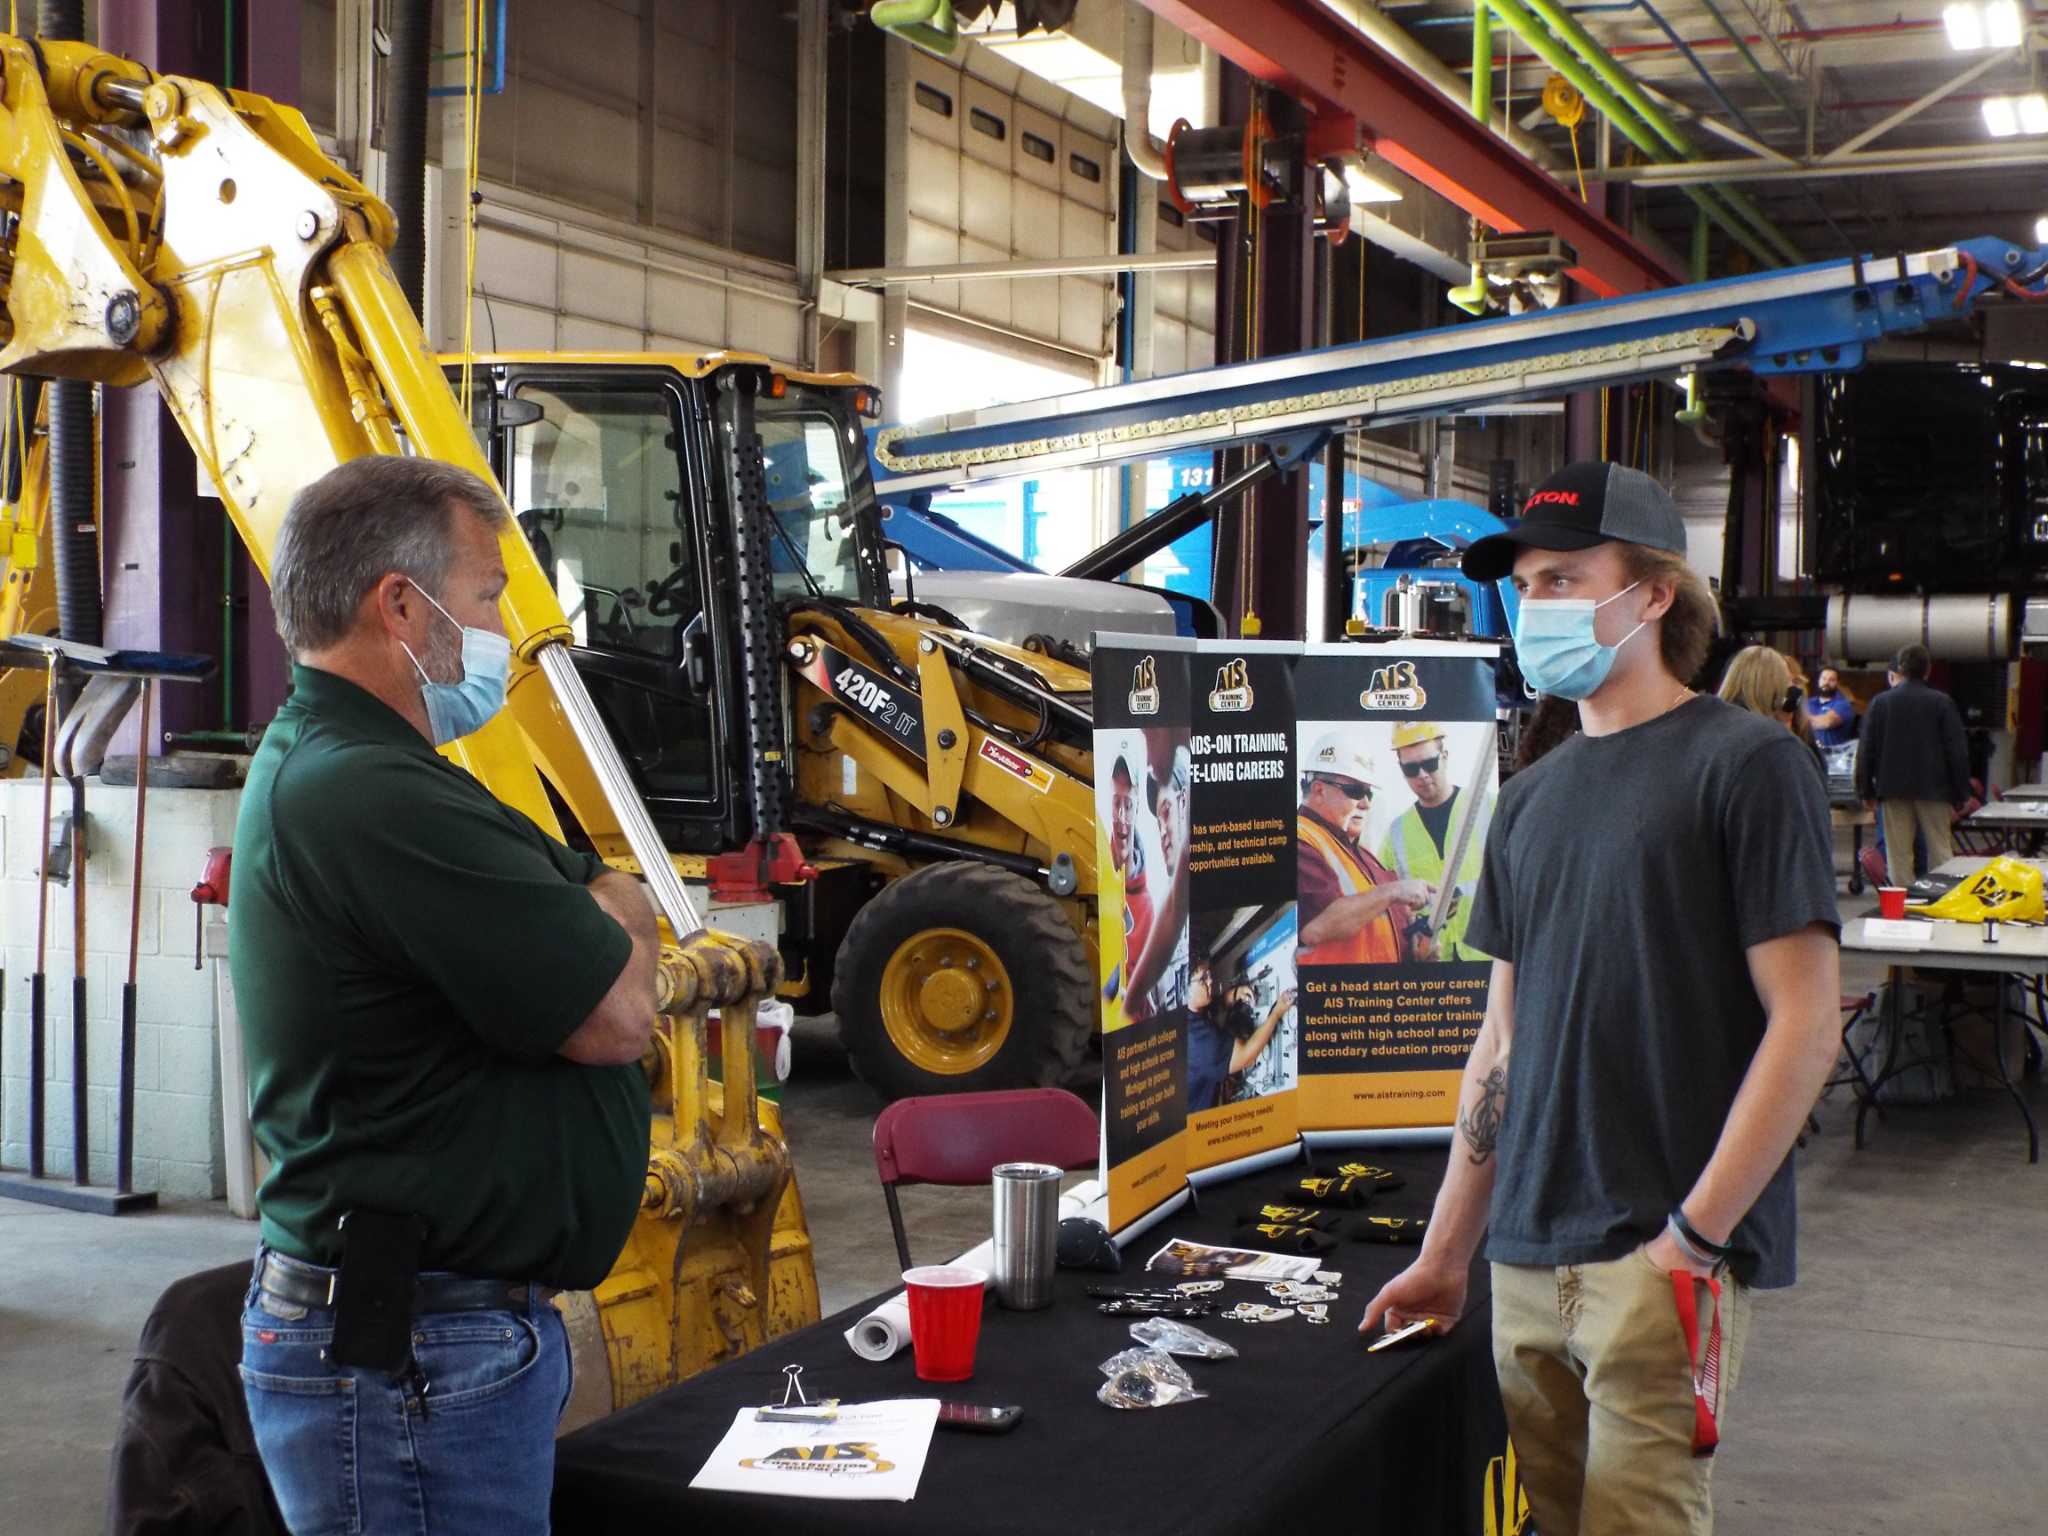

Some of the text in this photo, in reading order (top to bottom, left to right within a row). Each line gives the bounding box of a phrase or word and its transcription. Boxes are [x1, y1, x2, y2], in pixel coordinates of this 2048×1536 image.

[1217, 659, 1246, 693] AIS
[1370, 662, 1415, 693] AIS
[895, 712, 917, 736] IT
[1234, 733, 1288, 754] TRAINING,
[1236, 760, 1284, 781] CAREERS
[1193, 824, 1207, 836] has
[1209, 821, 1252, 834] work-based
[1217, 839, 1231, 850] and
[1233, 836, 1267, 849] technical
[1189, 856, 1240, 873] opportunities
[1305, 979, 1488, 993] Get a head start on your career.
[1323, 995, 1473, 1009] AIS Training Center offers
[1305, 1013, 1366, 1025] technician
[1369, 1012, 1391, 1023] and
[1394, 1011, 1442, 1023] operator
[1305, 1026, 1480, 1043] along with high school and po
[1306, 1046, 1368, 1058] secondary
[1371, 1044, 1428, 1056] education
[1353, 1090, 1446, 1101] www.aistraining.com
